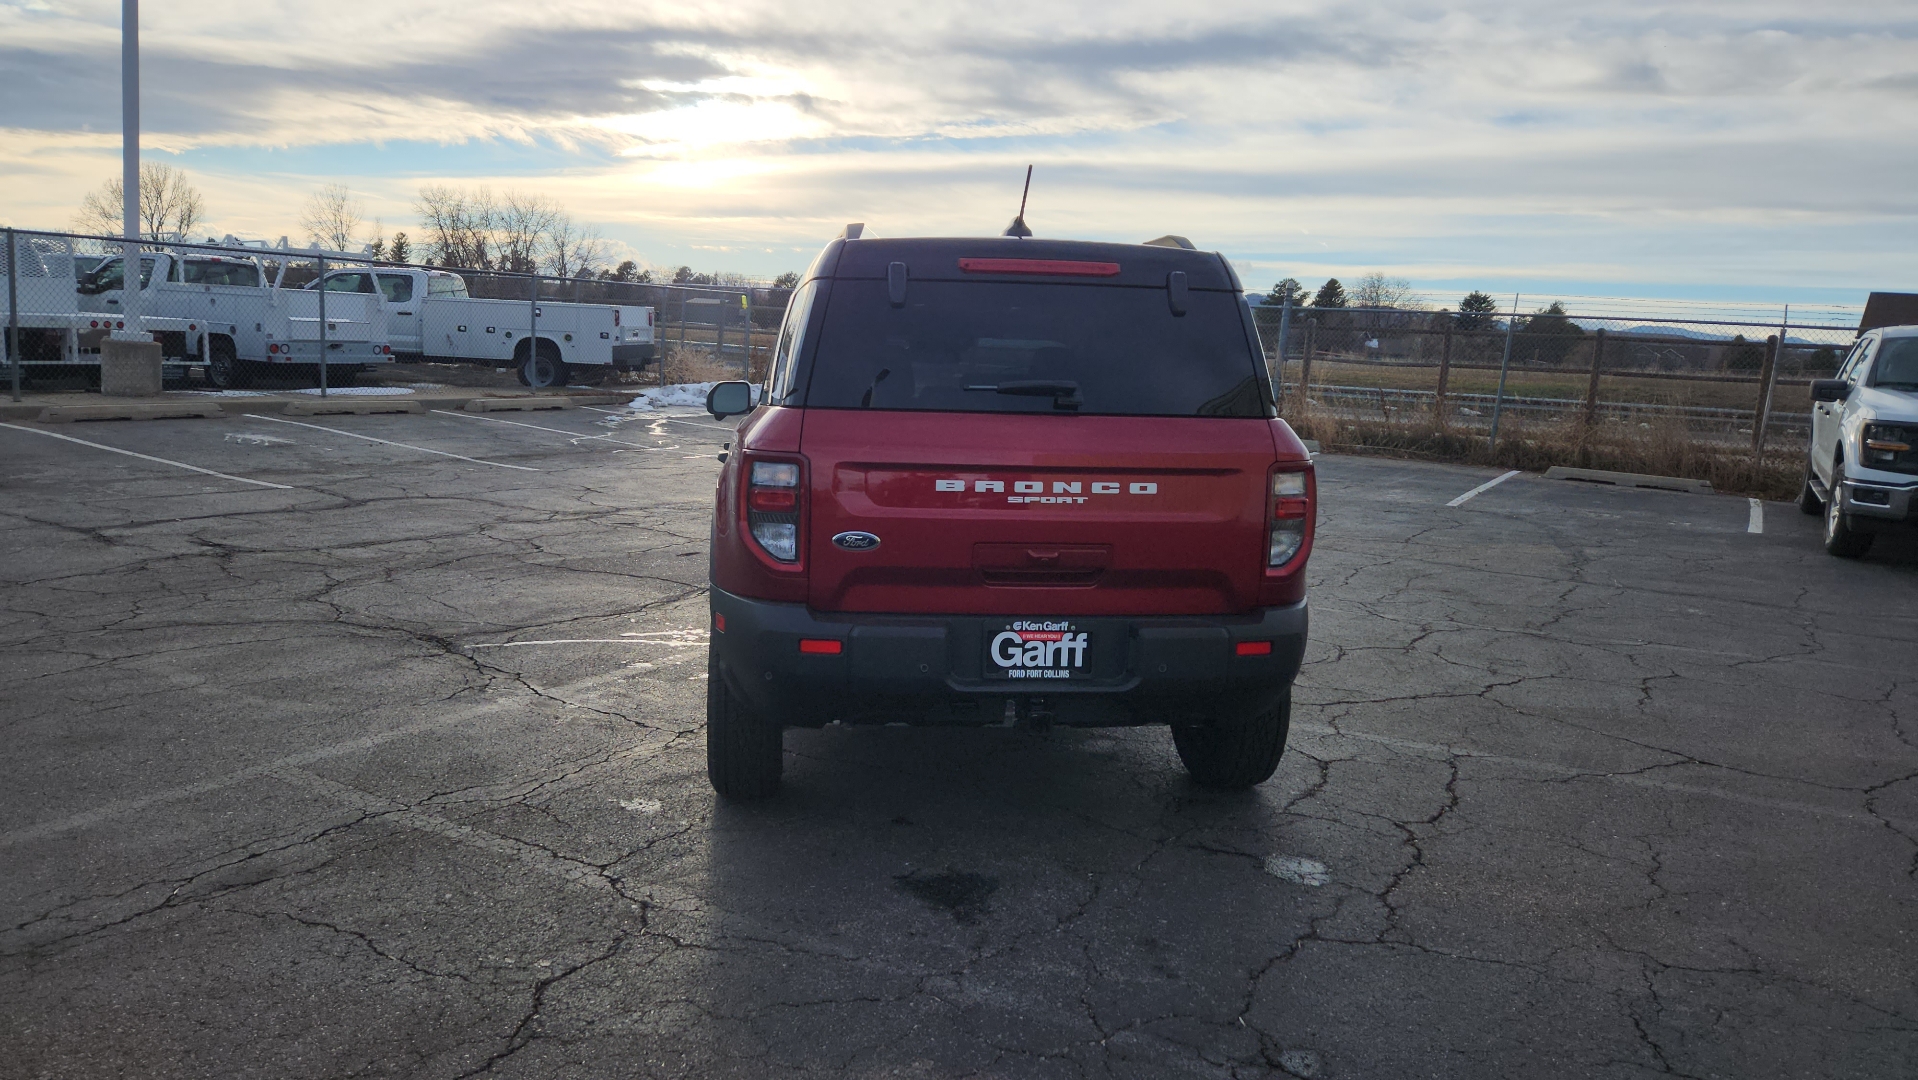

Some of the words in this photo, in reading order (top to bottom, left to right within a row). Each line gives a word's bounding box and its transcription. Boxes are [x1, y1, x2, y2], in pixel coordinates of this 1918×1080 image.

[935, 479, 1158, 494] BRONCO
[1007, 496, 1089, 504] SPORT
[843, 535, 869, 547] Ford
[1022, 621, 1042, 631] Ken
[1043, 621, 1069, 631] Garff
[990, 631, 1088, 667] Garff
[1008, 669, 1025, 678] FORD
[1026, 669, 1043, 678] FORT
[1043, 669, 1070, 678] COLLINS
